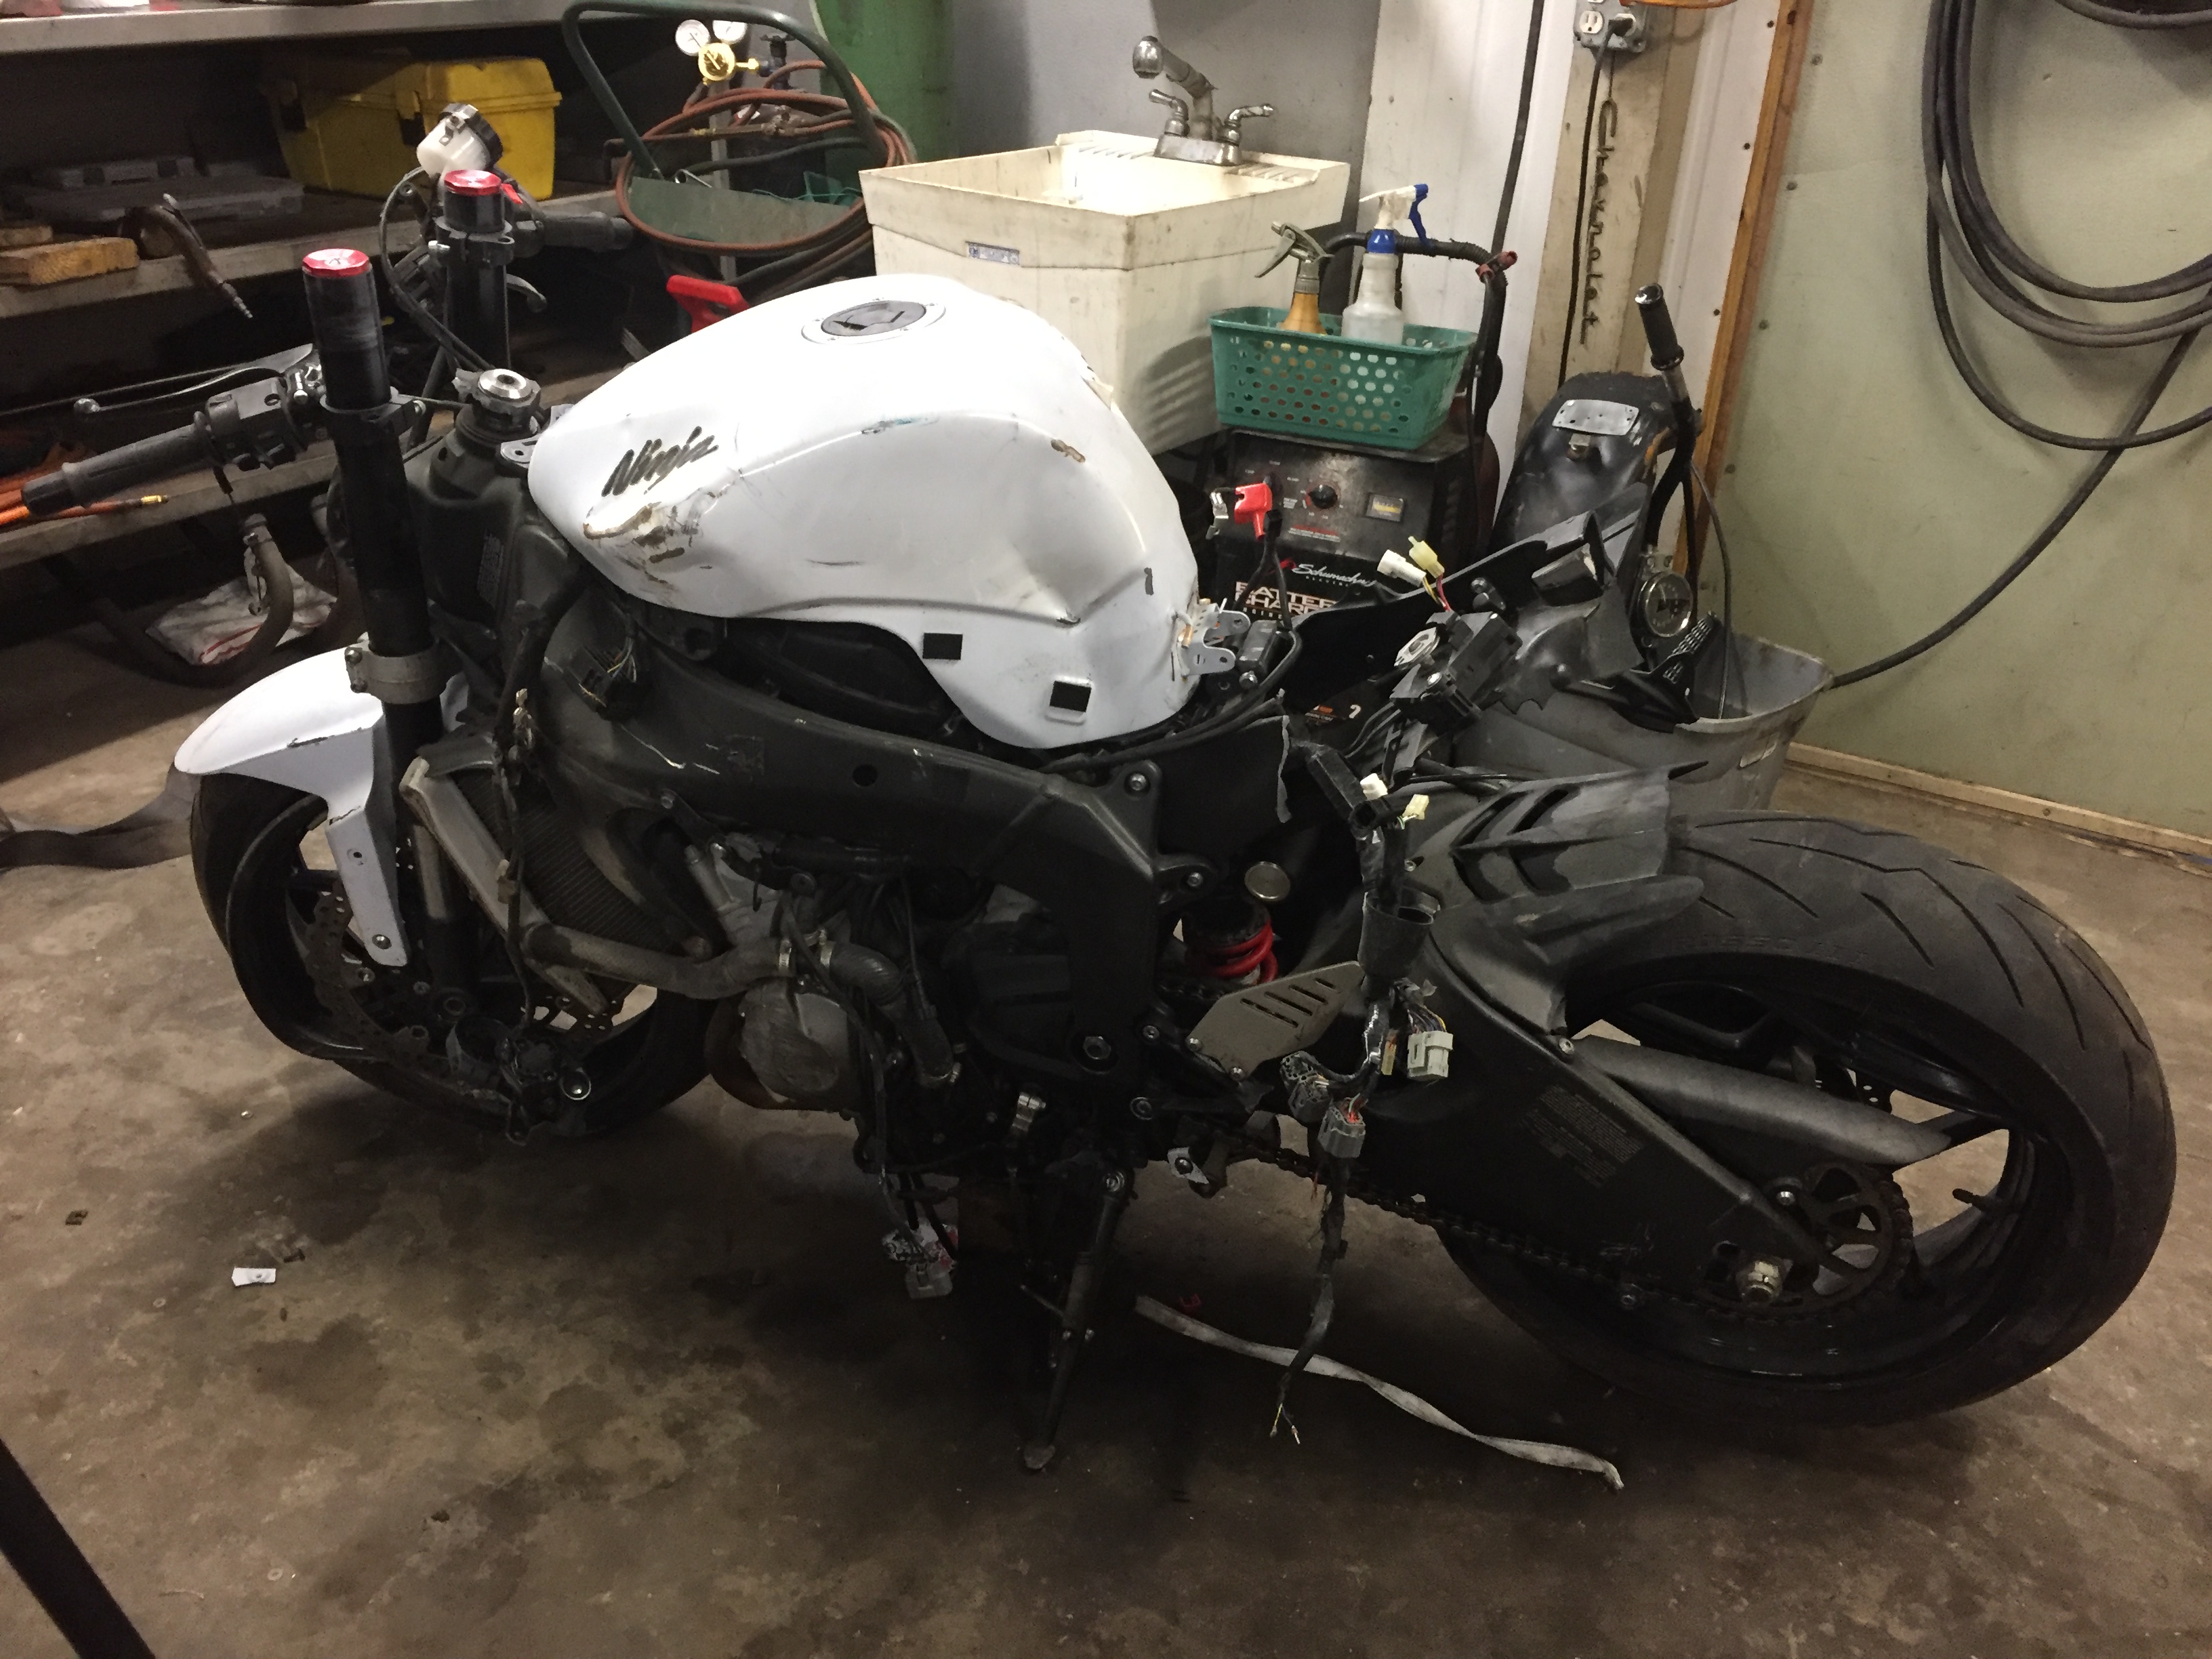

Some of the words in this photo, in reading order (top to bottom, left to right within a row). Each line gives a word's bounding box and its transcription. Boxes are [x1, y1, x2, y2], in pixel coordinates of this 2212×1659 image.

[1580, 99, 1618, 345] Chevrolet
[601, 426, 719, 497] Ninja
[1235, 581, 1339, 609] BATTER
